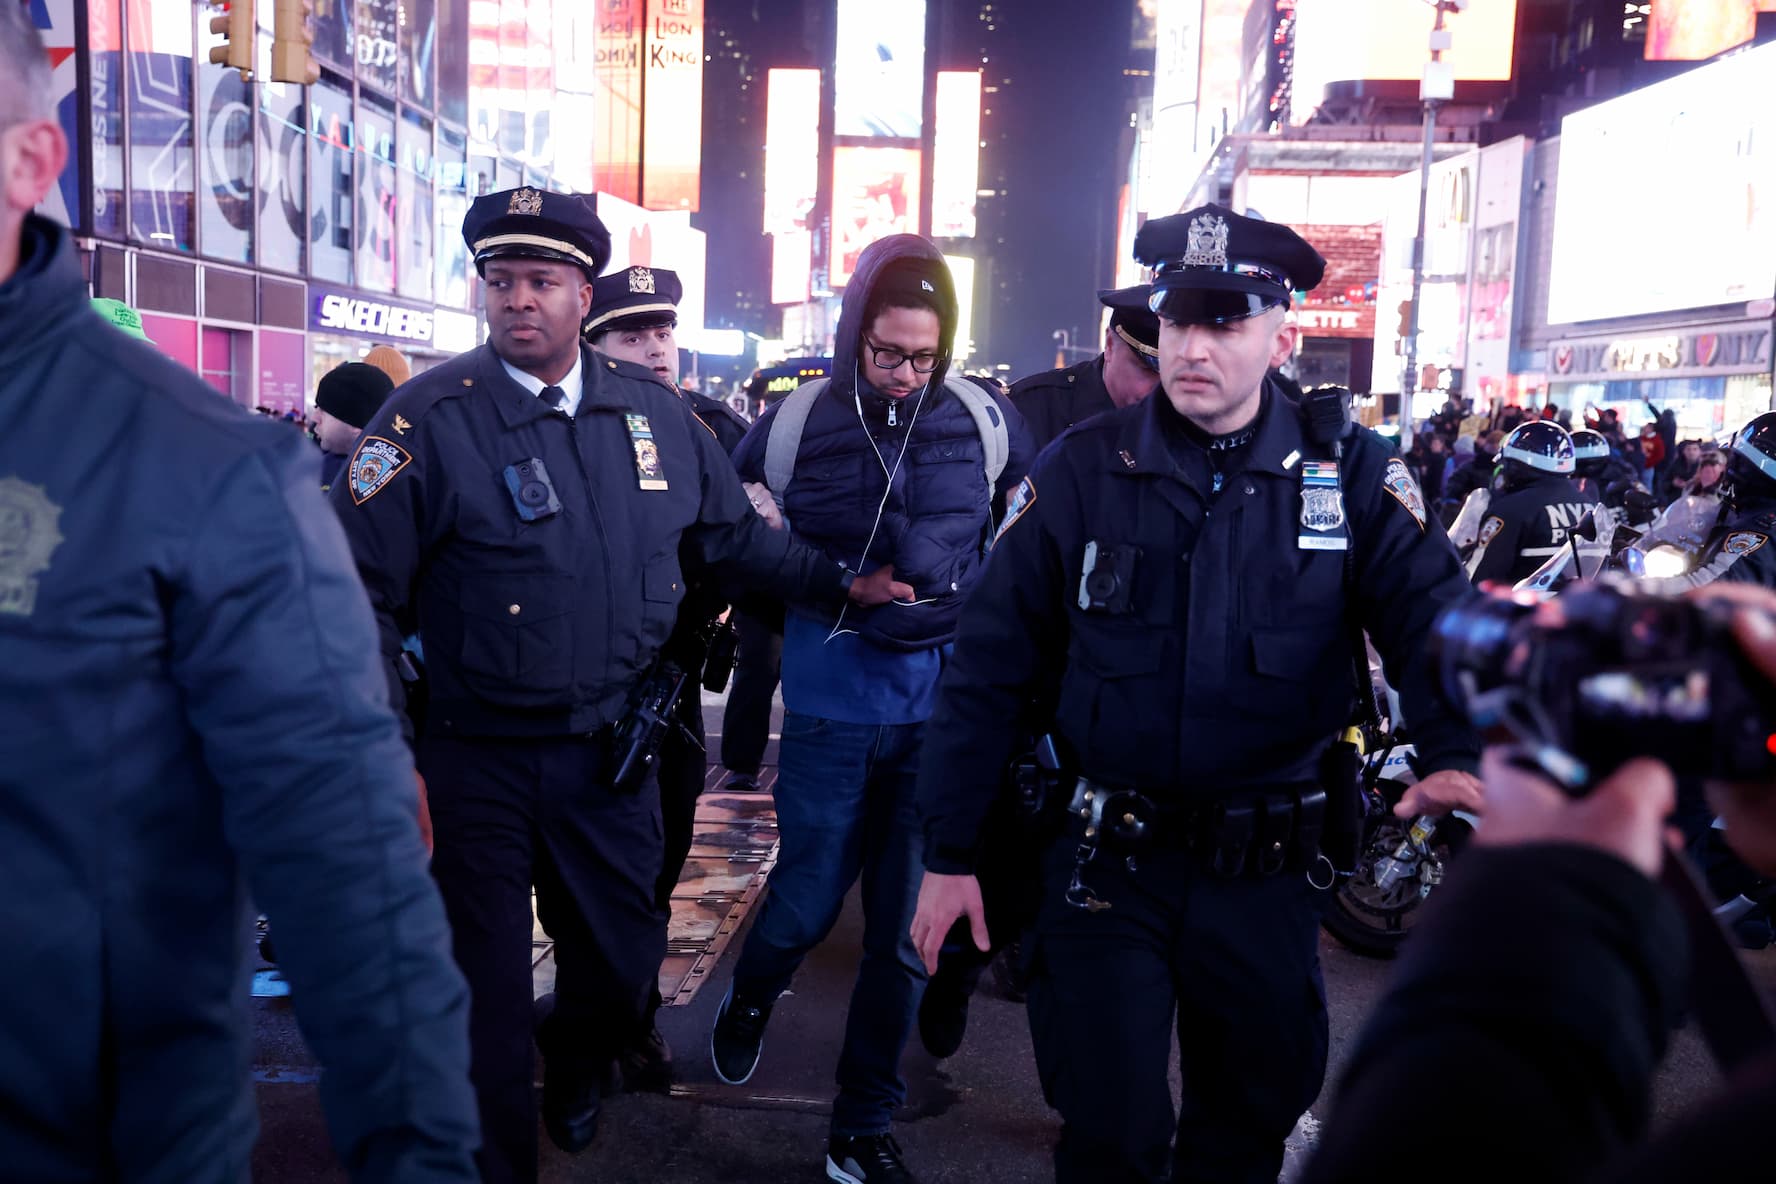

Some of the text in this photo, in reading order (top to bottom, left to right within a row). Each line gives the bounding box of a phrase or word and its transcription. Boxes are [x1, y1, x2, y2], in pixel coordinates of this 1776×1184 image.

[655, 16, 692, 39] LION
[651, 43, 697, 68] KING
[92, 113, 107, 188] CBS
[320, 294, 434, 341] SKECHERS
[374, 441, 399, 455] POLICE
[1211, 428, 1256, 450] NYP
